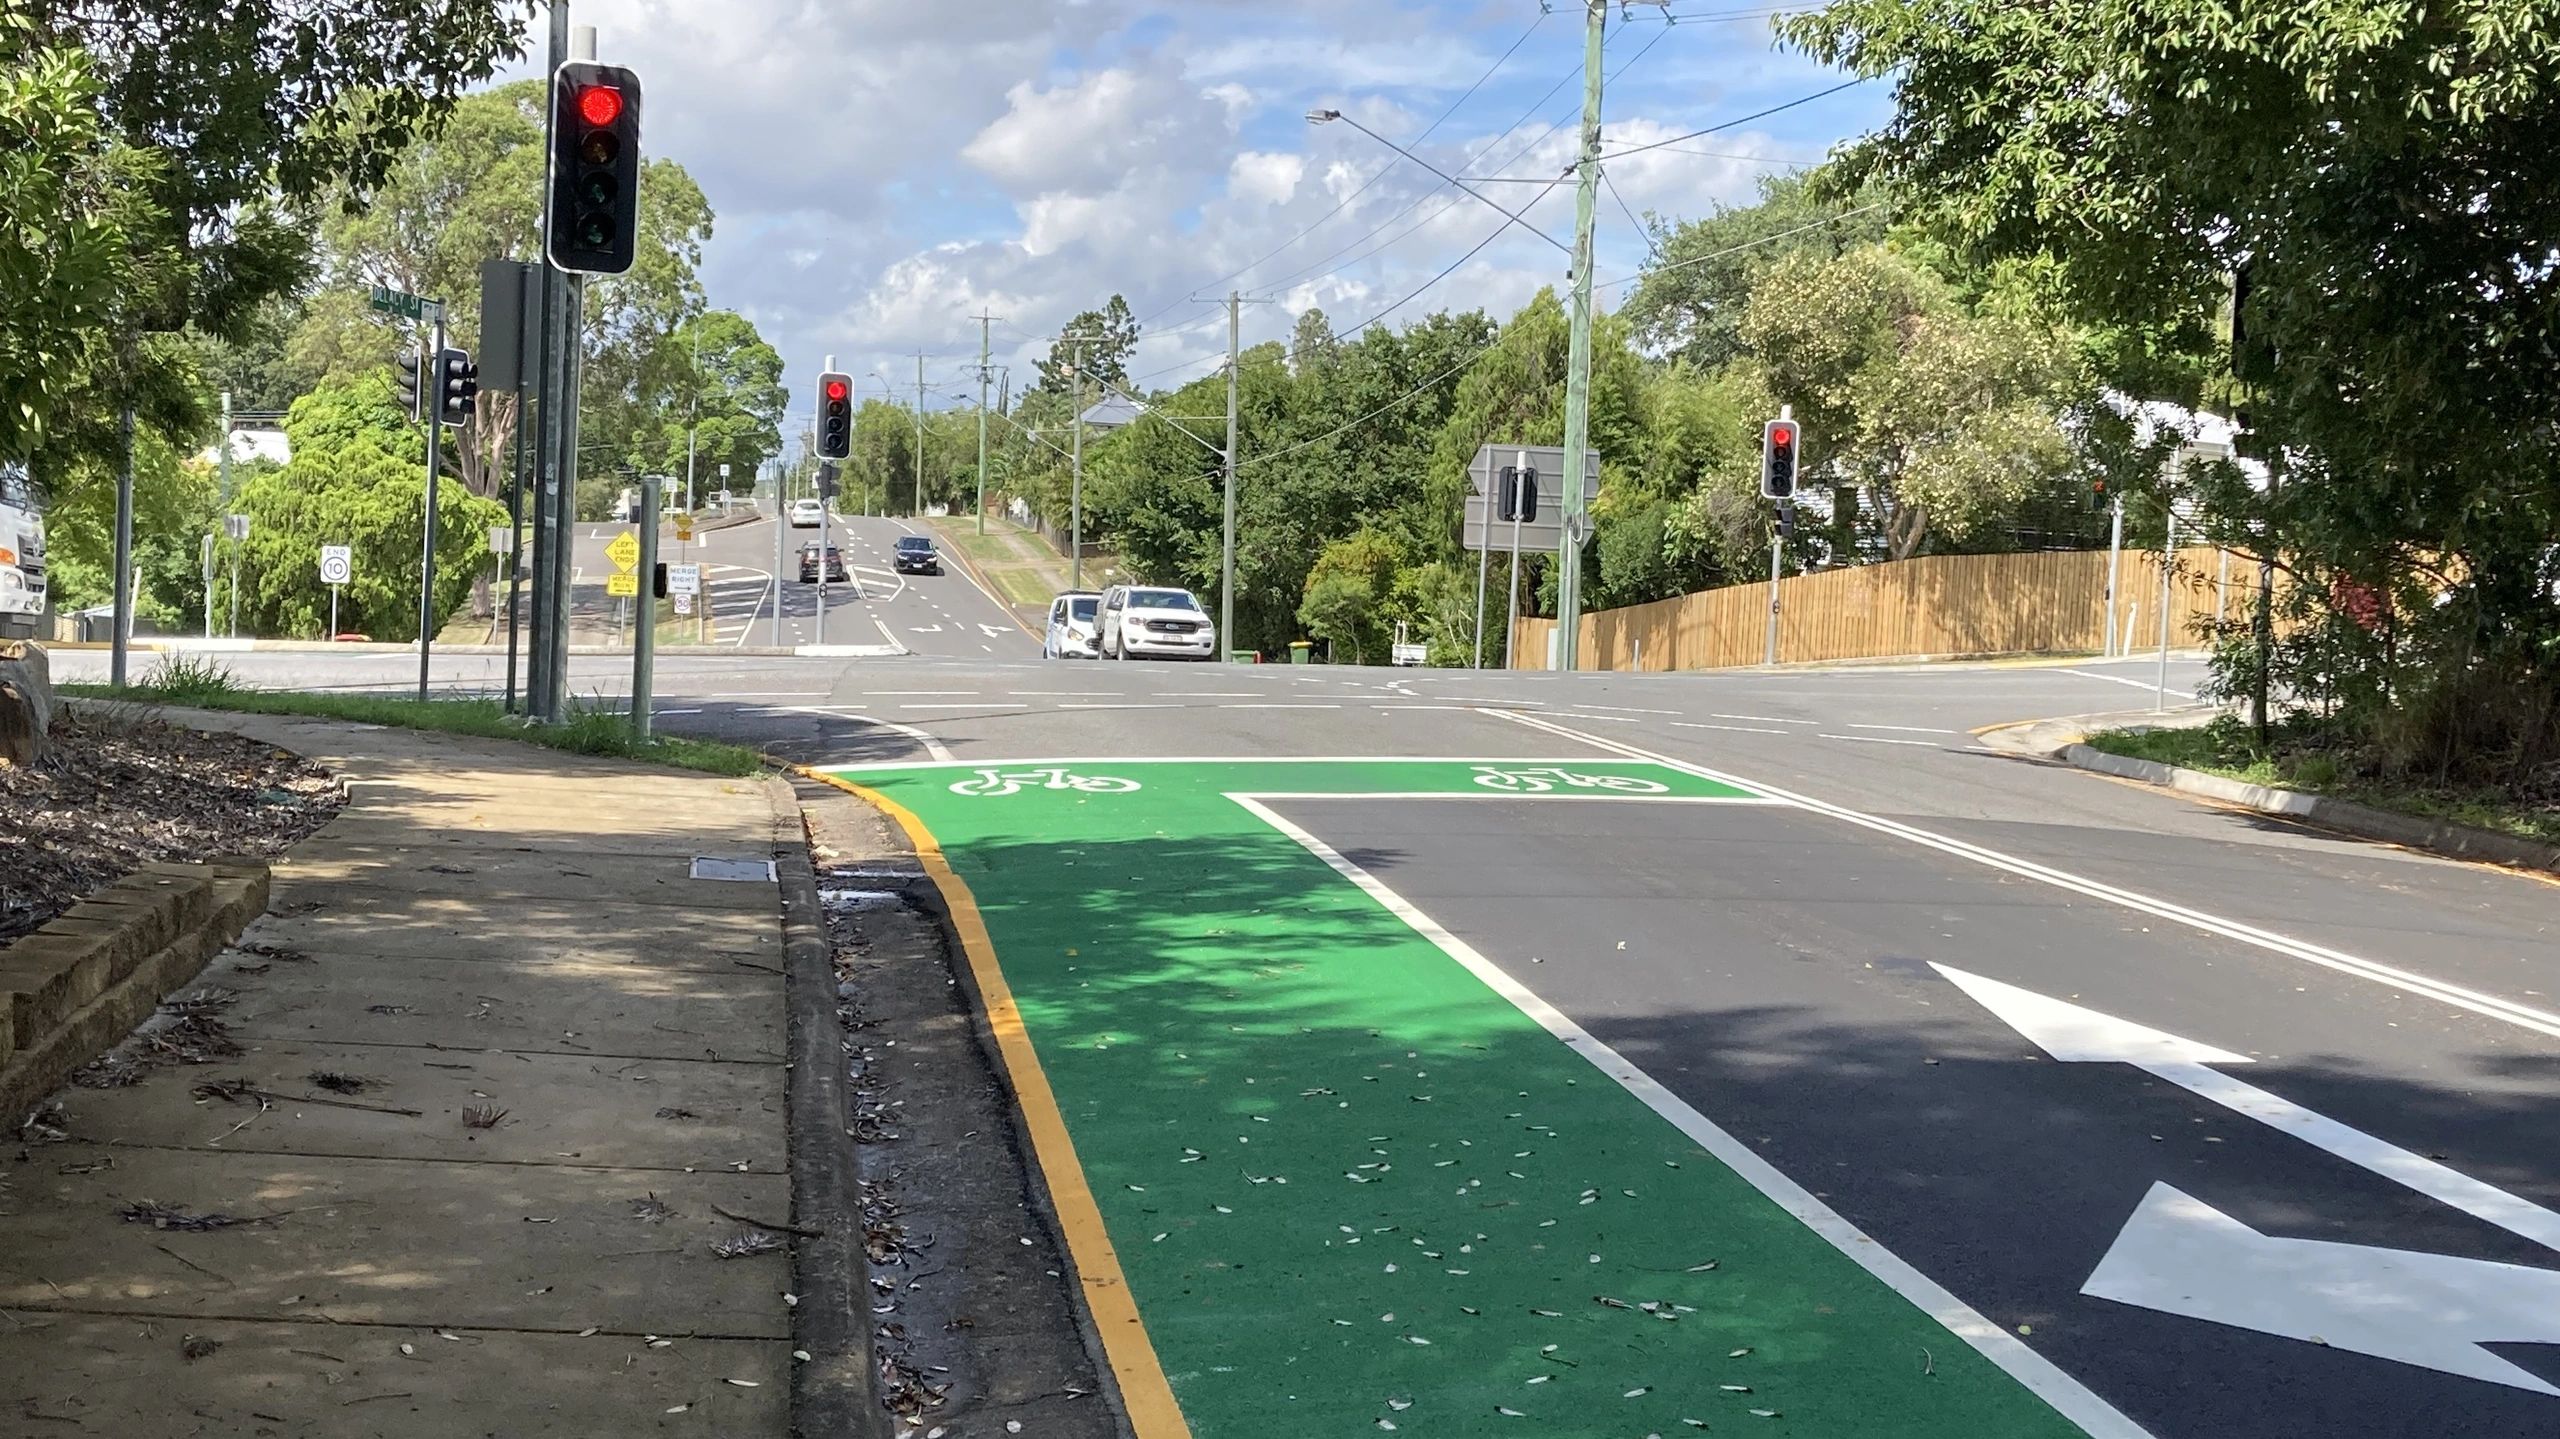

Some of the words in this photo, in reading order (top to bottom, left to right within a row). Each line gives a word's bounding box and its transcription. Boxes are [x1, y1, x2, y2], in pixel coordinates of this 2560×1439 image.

[373, 286, 405, 307] DELACY
[410, 295, 420, 311] ST
[326, 548, 346, 556] END
[328, 563, 343, 575] 10
